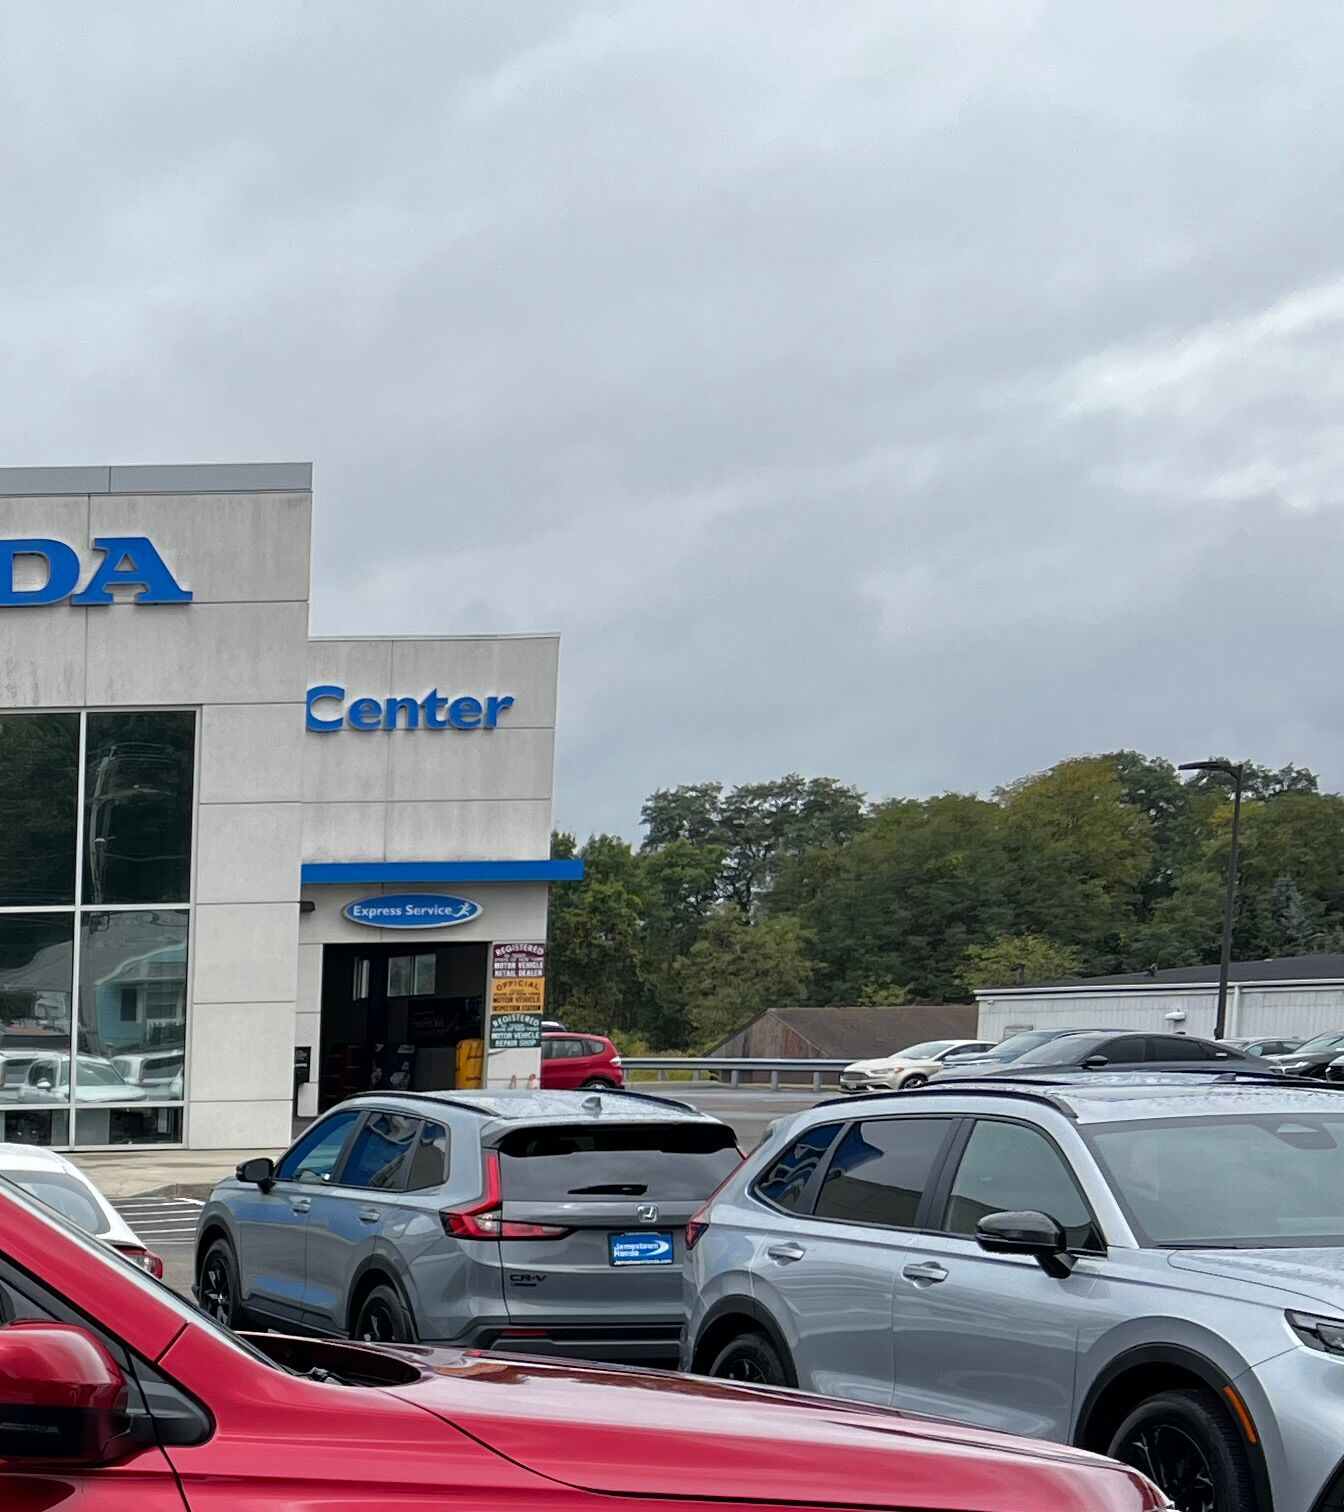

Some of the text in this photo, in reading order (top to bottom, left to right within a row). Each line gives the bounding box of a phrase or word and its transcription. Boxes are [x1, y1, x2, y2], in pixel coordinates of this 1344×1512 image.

[306, 685, 515, 732] Center
[353, 904, 452, 919] Express Service
[495, 943, 544, 957] REGISTERED
[496, 980, 540, 991] OFFICIAL
[492, 1014, 540, 1028] REGISTERED
